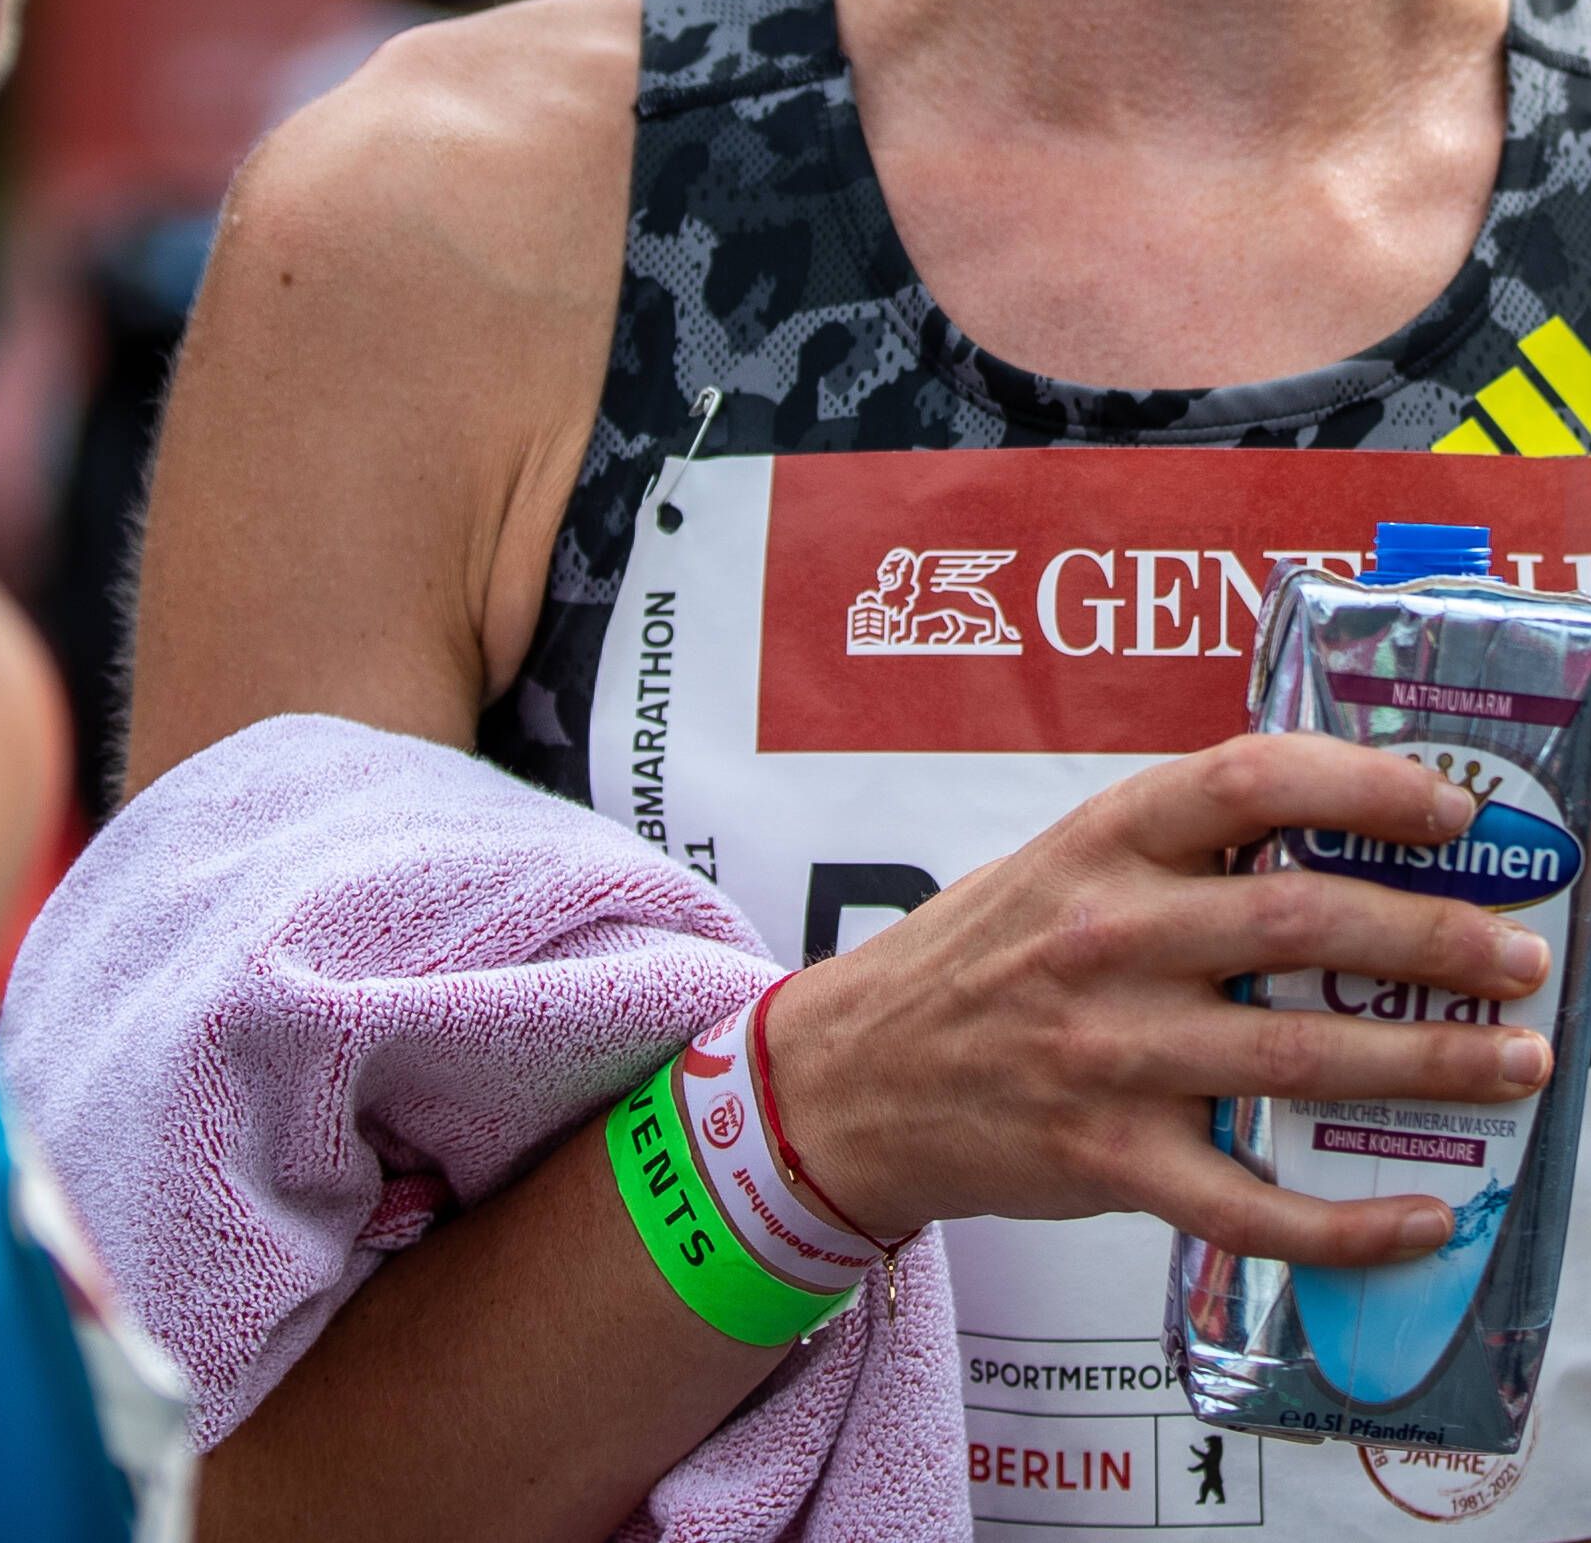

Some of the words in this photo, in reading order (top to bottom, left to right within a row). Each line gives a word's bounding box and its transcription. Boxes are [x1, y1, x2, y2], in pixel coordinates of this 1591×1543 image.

[1392, 682, 1513, 718] NATRIUMARM
[631, 591, 677, 856] BMARATHON
[1393, 1109, 1517, 1138] MINERALWASSER
[1324, 1129, 1366, 1151] OHNE
[1368, 1134, 1476, 1162] KOHLENSÄURE
[1348, 1418, 1446, 1445] Pfandfrei
[969, 1444, 1131, 1491] BERLIN
